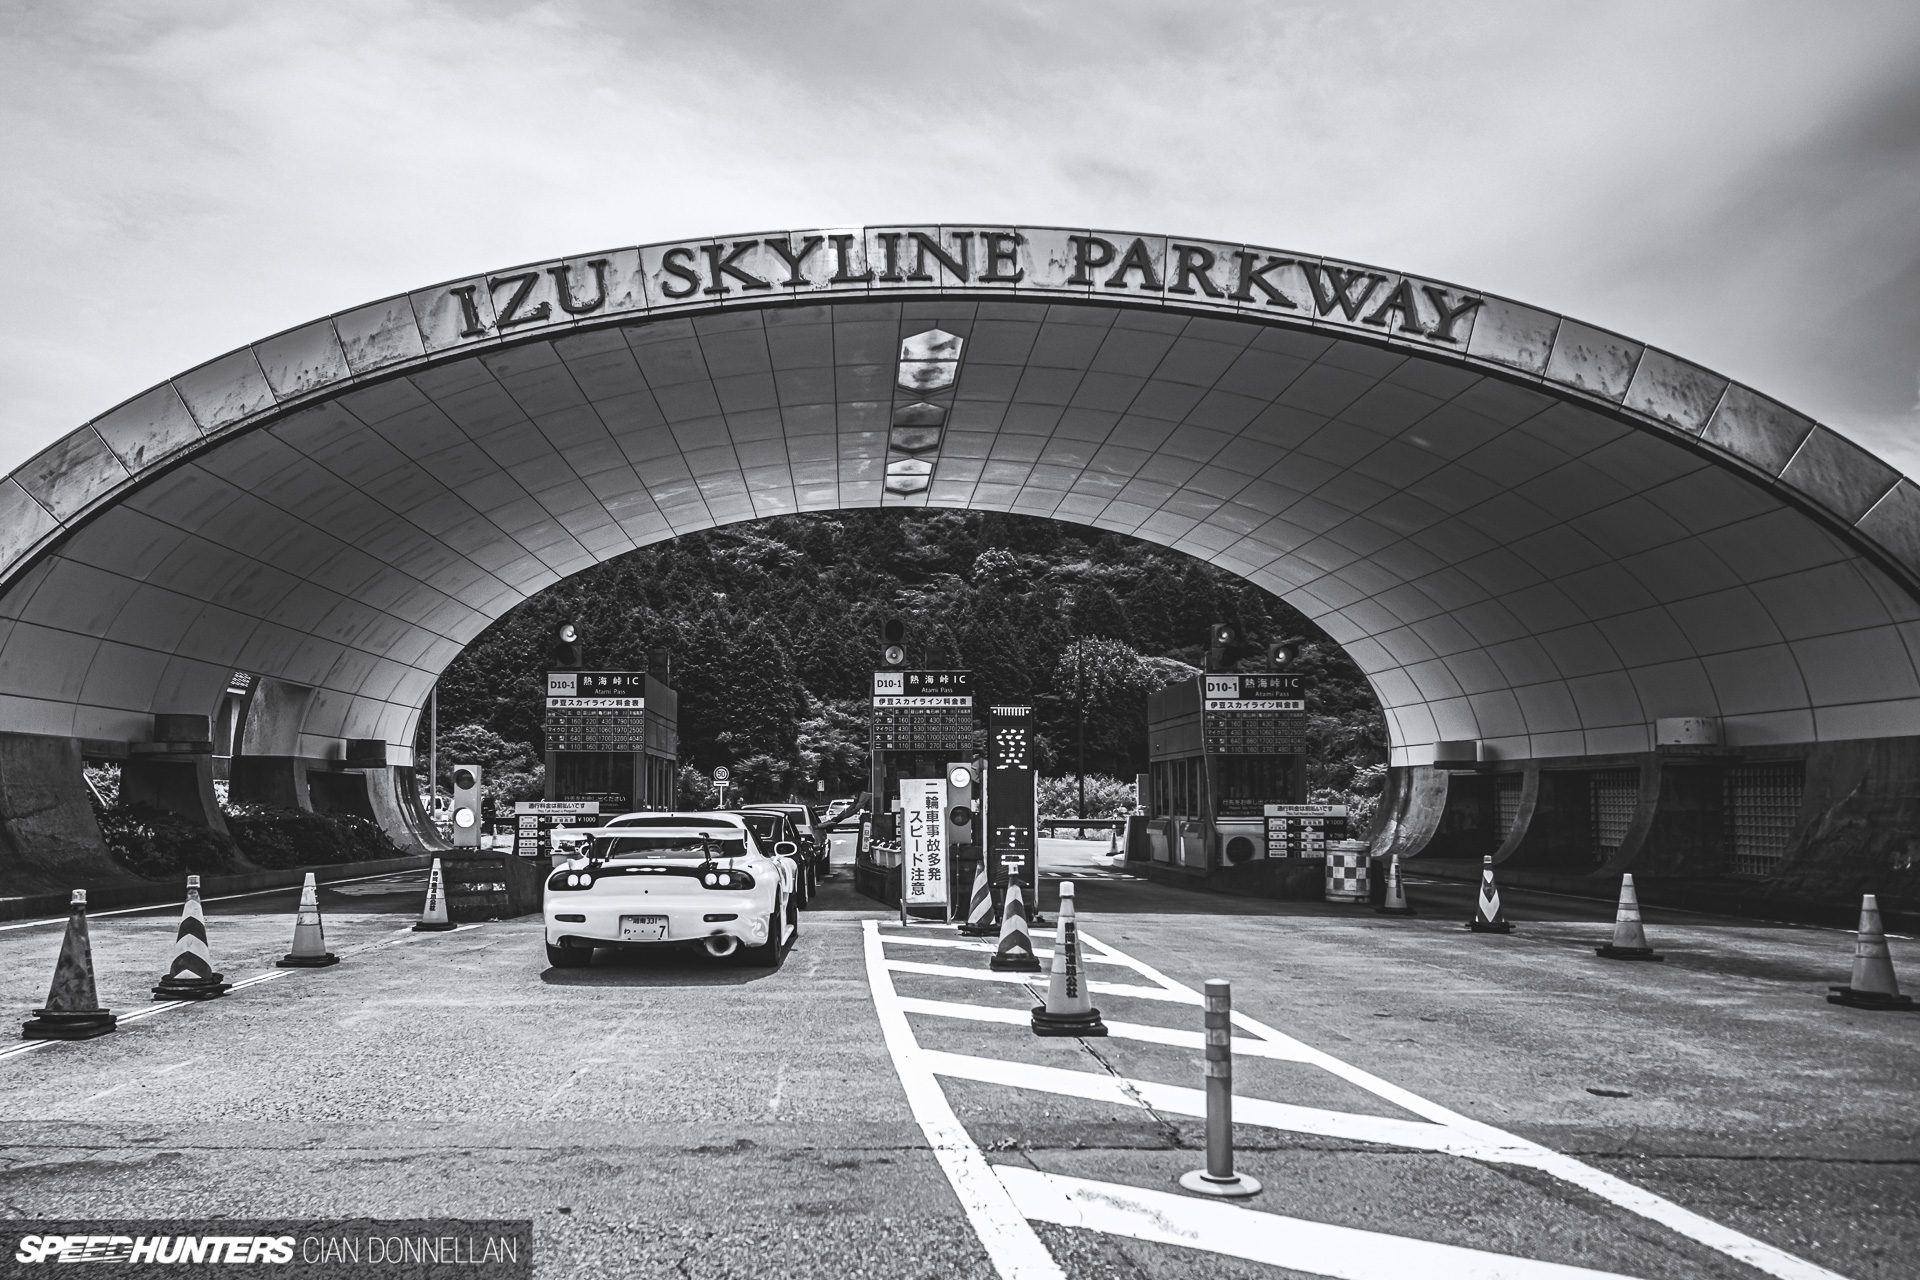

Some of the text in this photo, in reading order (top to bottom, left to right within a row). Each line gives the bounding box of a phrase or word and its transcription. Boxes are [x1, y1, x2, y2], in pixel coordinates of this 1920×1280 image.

[449, 231, 1484, 343] IZU SKYLINE PARKWAY
[1208, 683, 1237, 692] D10-1
[910, 811, 925, 896] スピード注意
[926, 783, 941, 880] 二輪車事故多発
